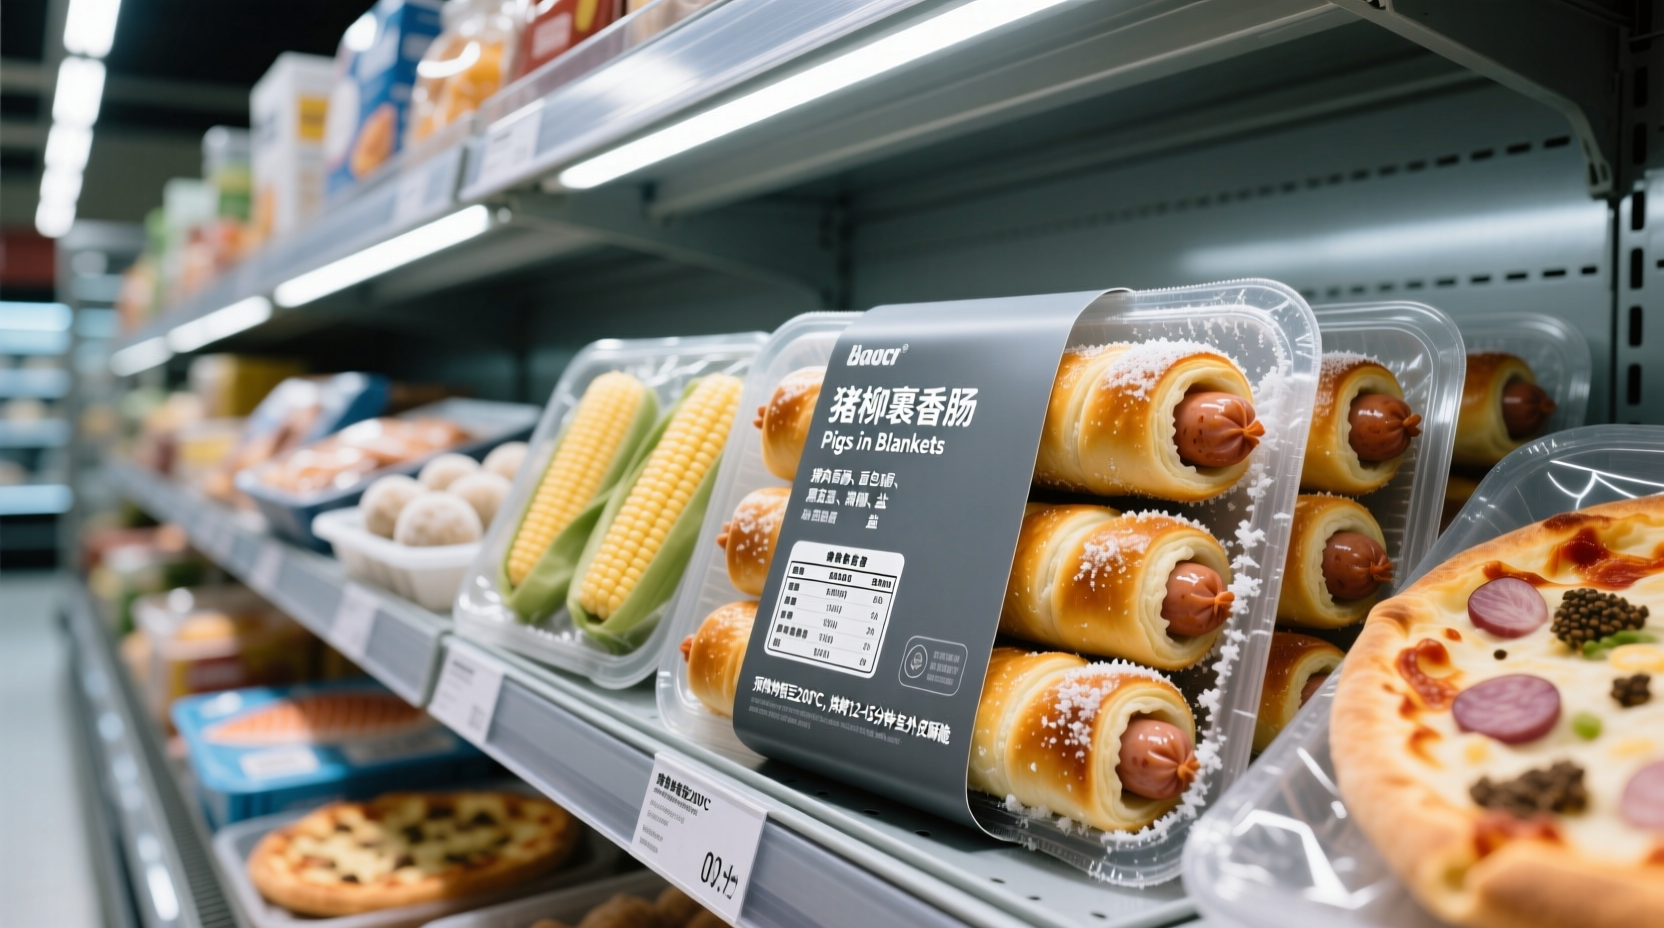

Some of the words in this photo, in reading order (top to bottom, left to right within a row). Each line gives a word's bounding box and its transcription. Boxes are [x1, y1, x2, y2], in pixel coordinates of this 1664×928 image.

[820, 430, 854, 455] Pigs
[856, 431, 872, 451] in
[875, 432, 945, 455] Blankets
